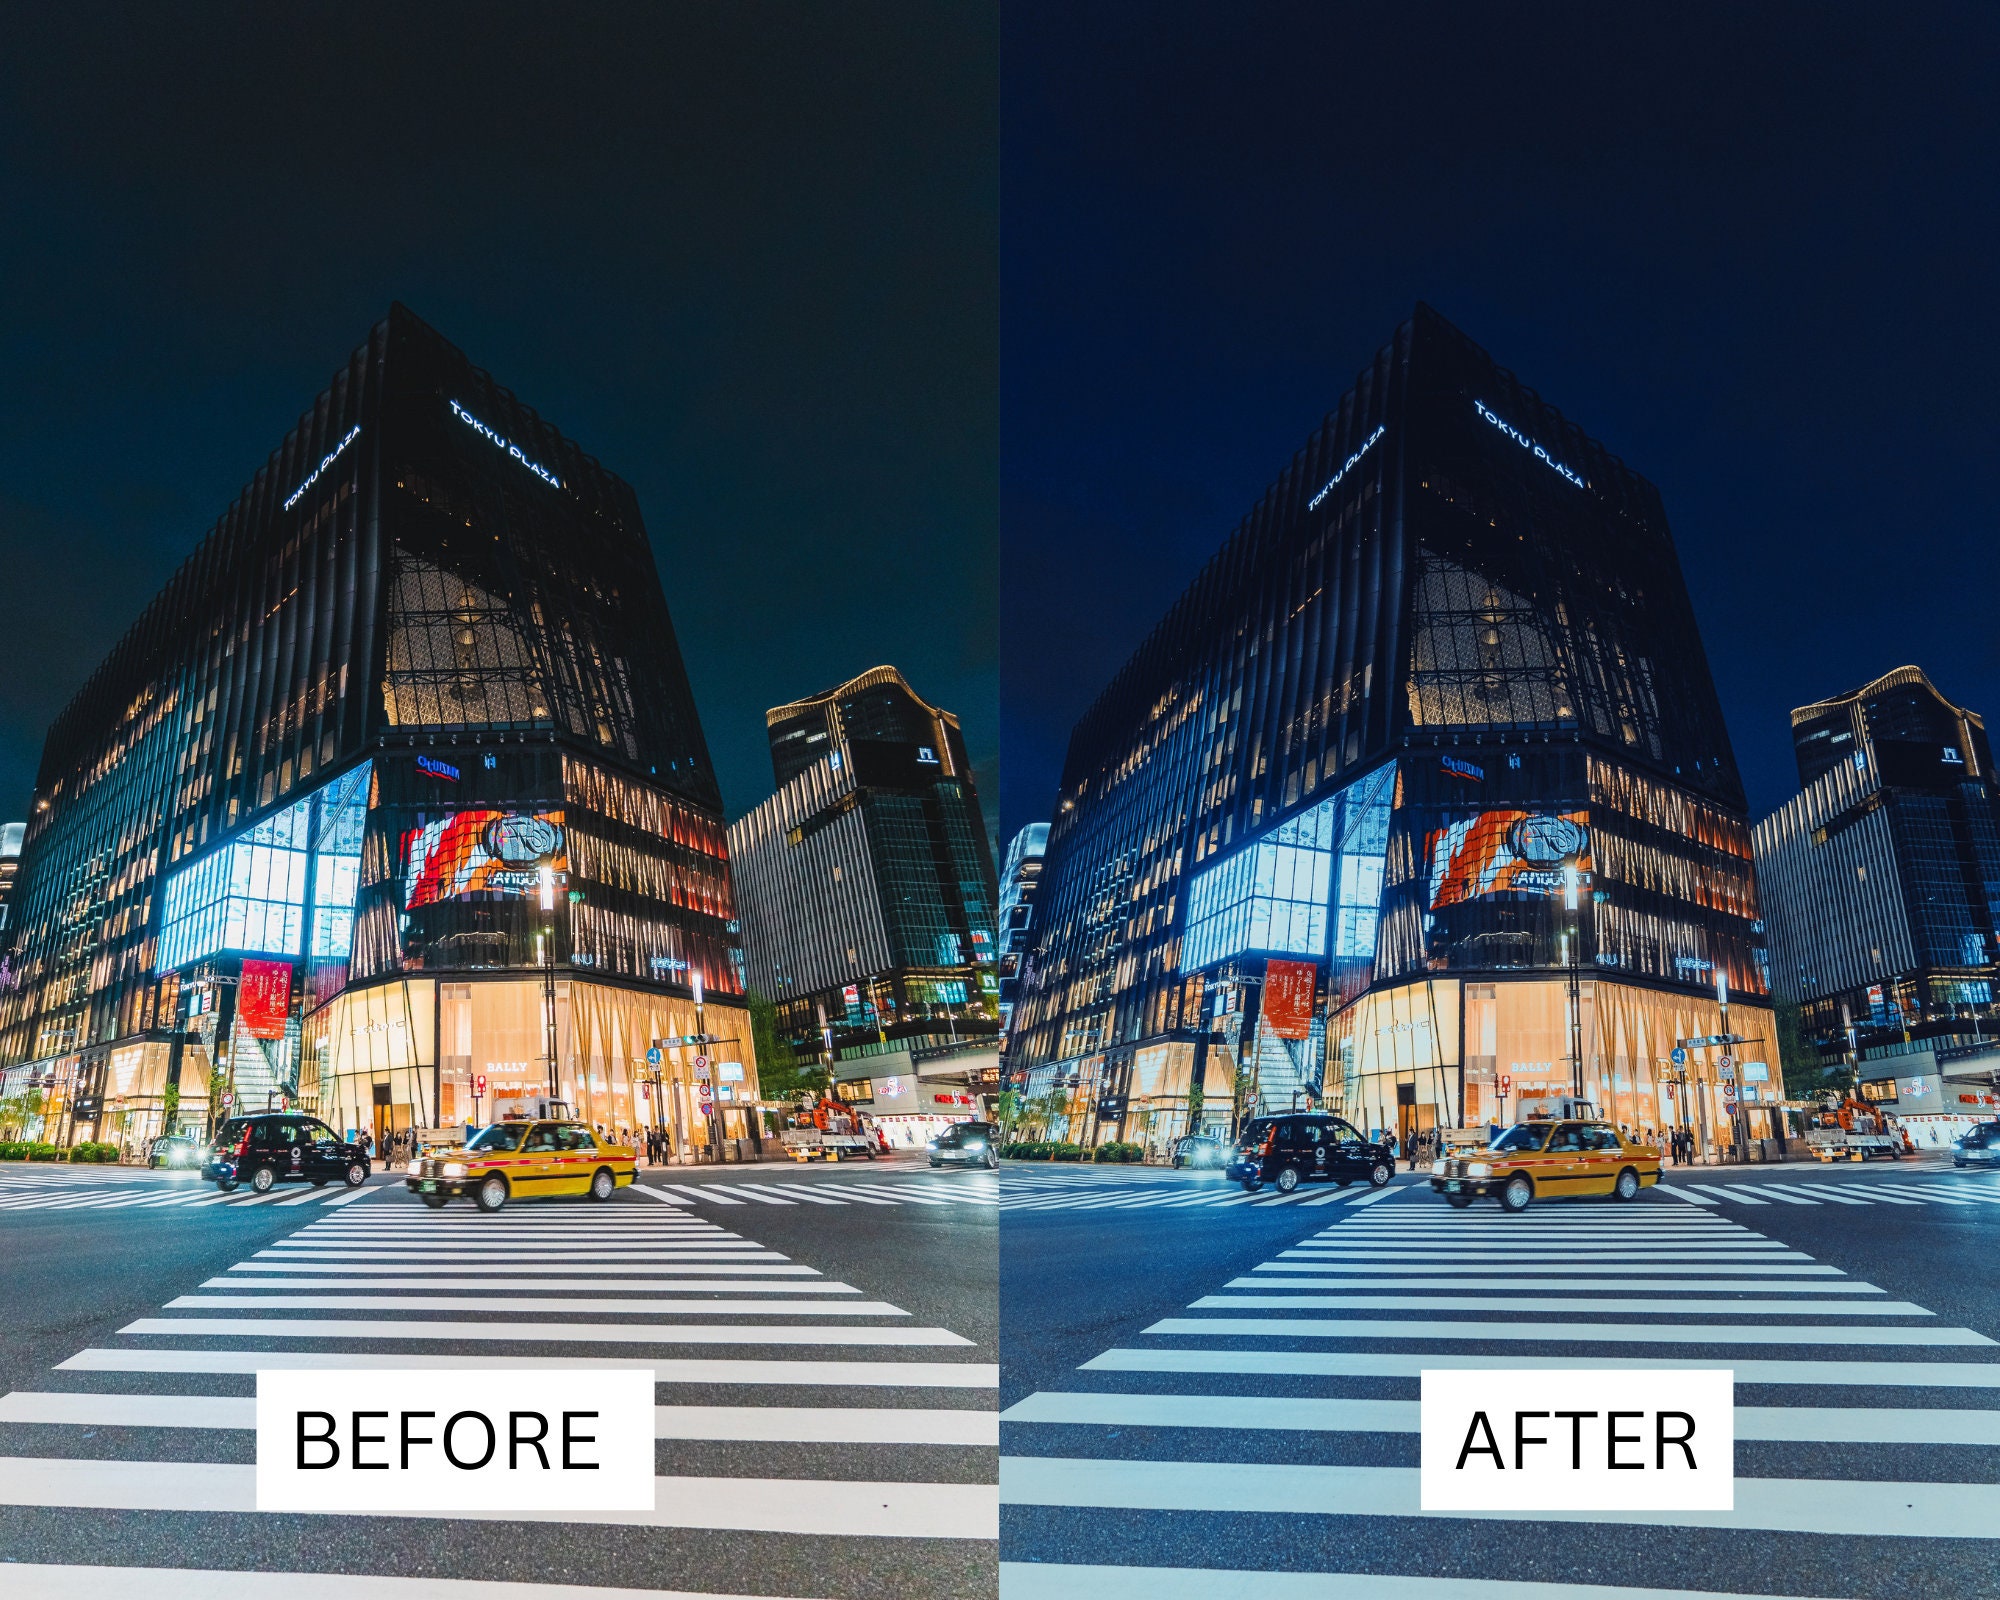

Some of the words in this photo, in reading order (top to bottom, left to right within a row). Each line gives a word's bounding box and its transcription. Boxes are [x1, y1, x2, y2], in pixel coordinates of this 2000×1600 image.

[283, 469, 318, 511] TOKYU
[321, 424, 360, 470] PLAZA
[450, 399, 506, 448] TOKYU
[509, 443, 560, 489] PLAZA
[1307, 469, 1342, 511] TOKYU
[1345, 424, 1384, 470] PLAZA
[1474, 399, 1530, 448] TOKYU
[1533, 443, 1584, 489] PLAZA
[486, 1062, 528, 1073] BALLY
[1510, 1062, 1552, 1073] BALLY
